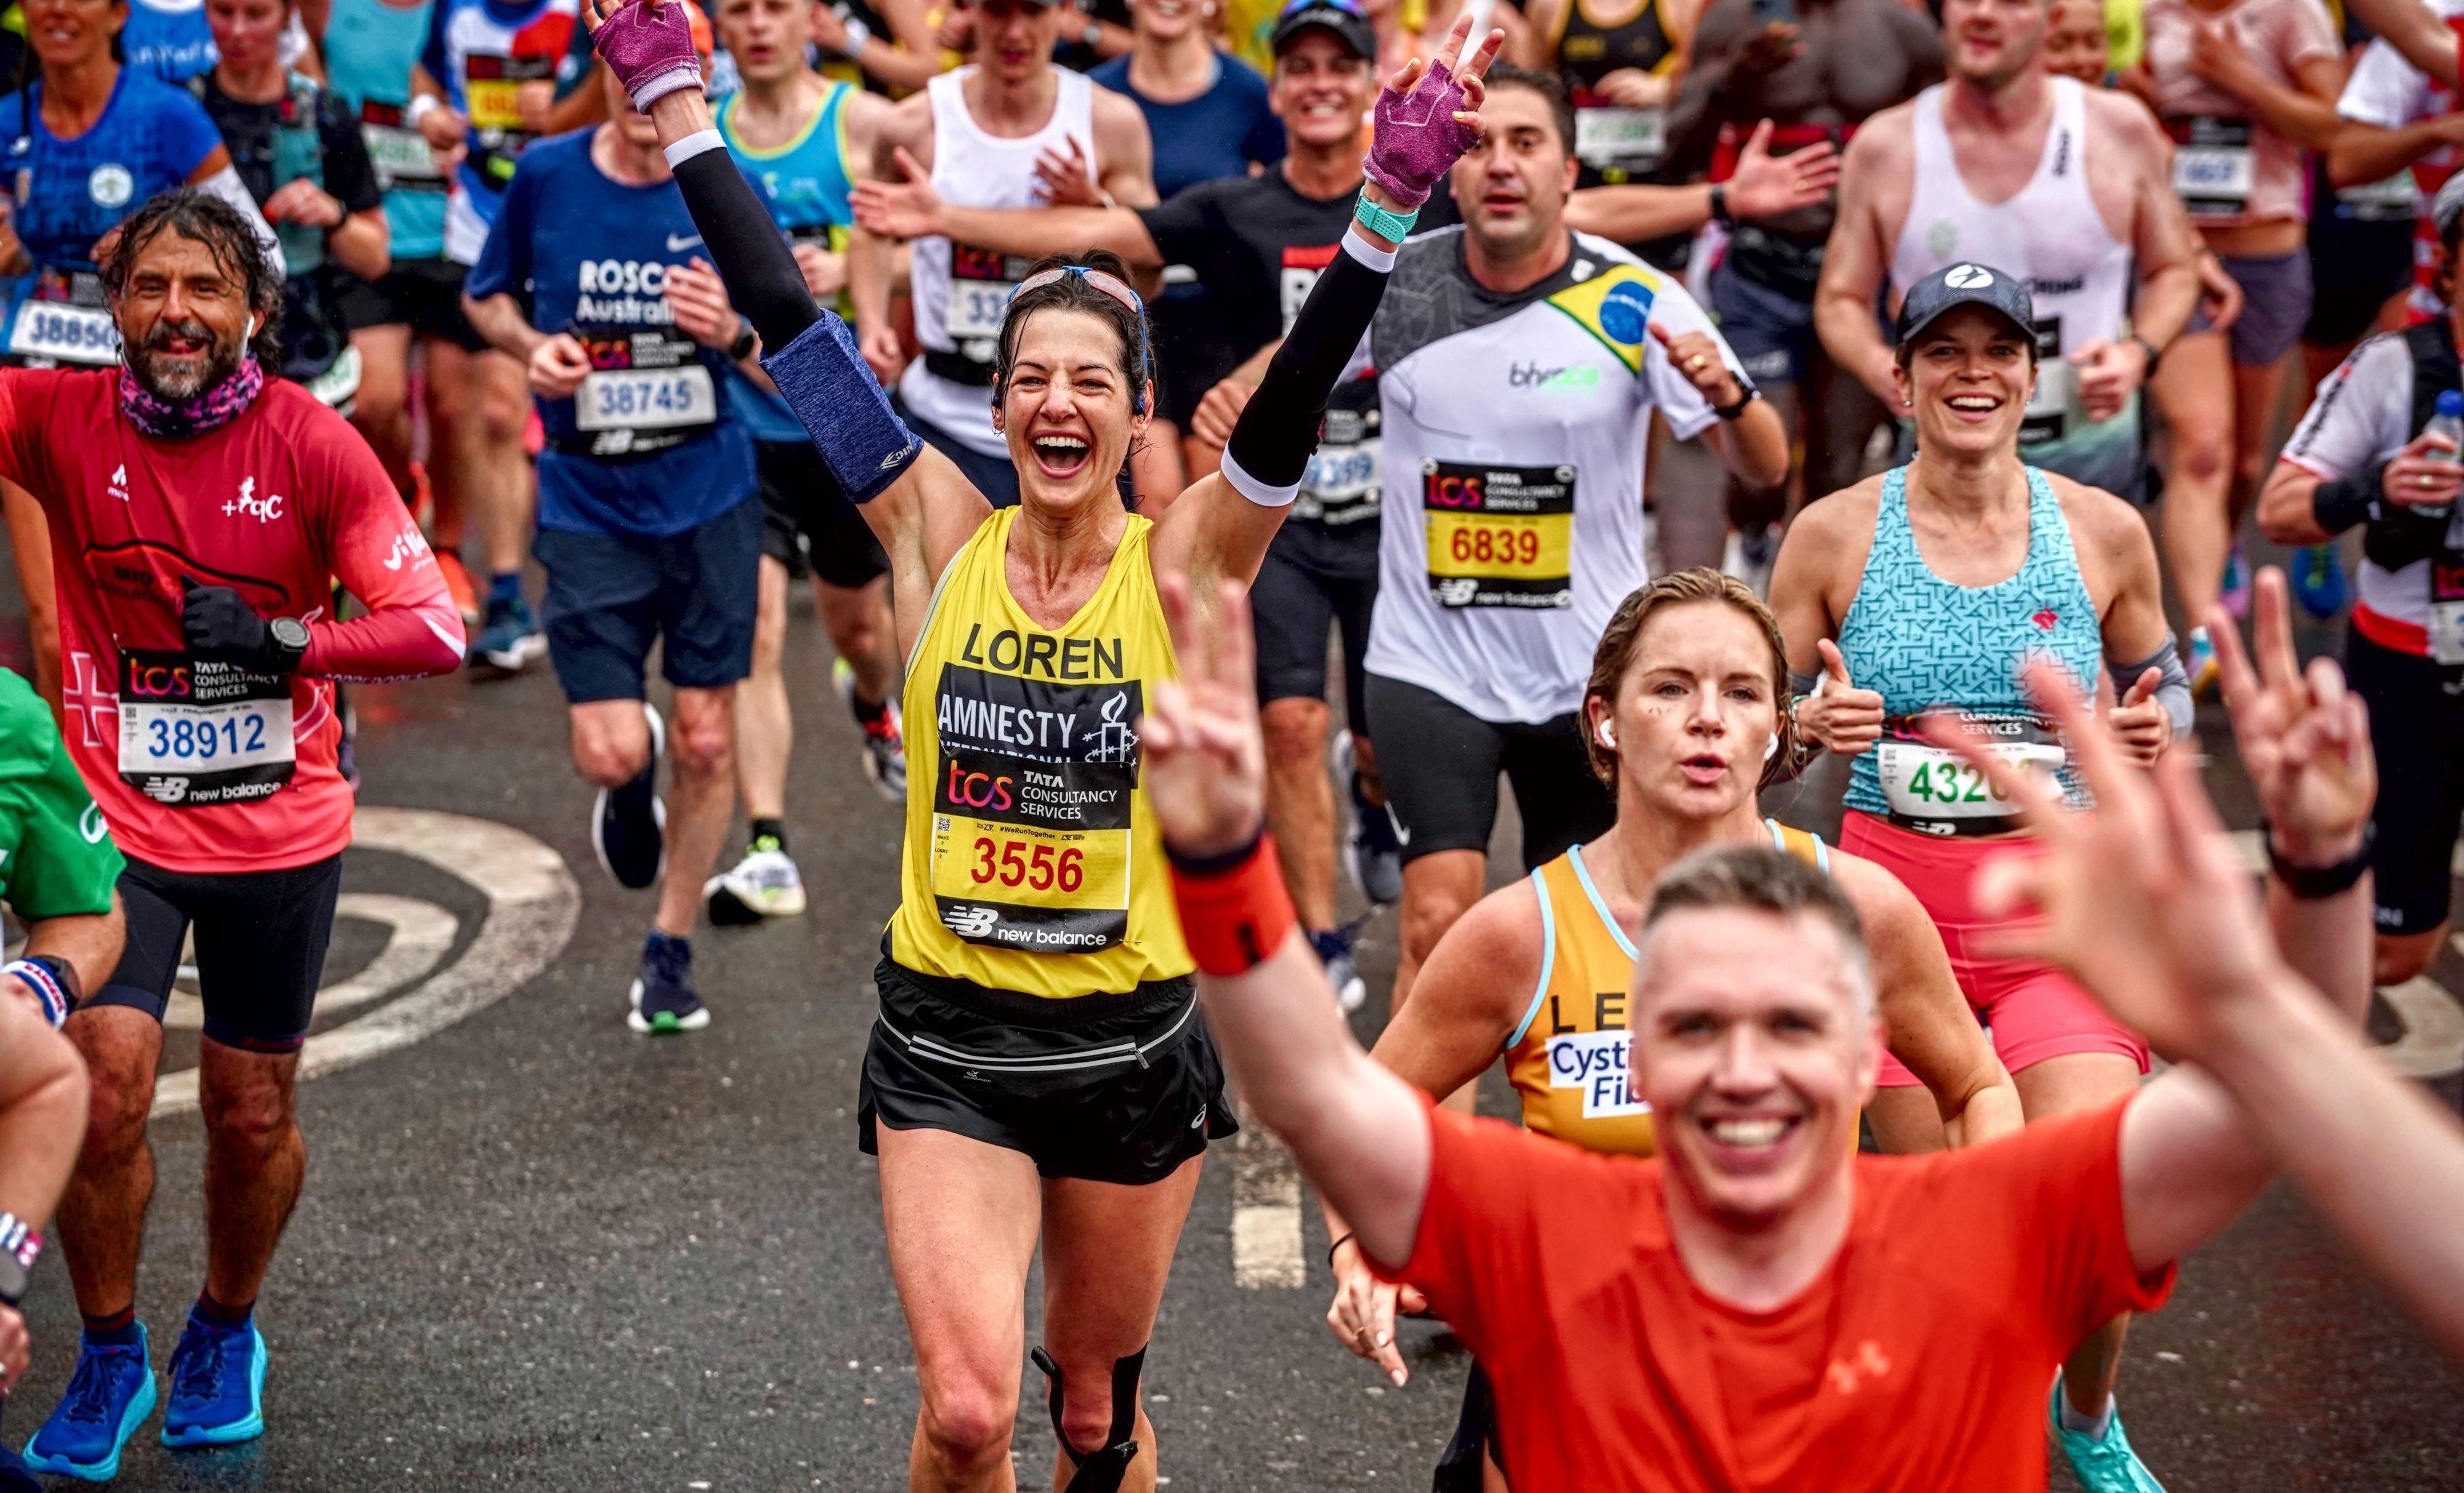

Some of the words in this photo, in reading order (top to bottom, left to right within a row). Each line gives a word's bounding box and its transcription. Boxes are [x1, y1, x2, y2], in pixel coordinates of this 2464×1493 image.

[579, 259, 671, 295] ROSC
[598, 379, 693, 415] 38745
[1429, 474, 1481, 508] tcs
[1452, 527, 1538, 564] 6839
[1475, 592, 1503, 605] new
[962, 623, 1123, 679] LOREN
[131, 658, 190, 695] tcs
[194, 661, 229, 673] TATA
[194, 673, 278, 687] CONSULTANCY
[195, 684, 248, 700] SERVICES
[938, 694, 1076, 749] AMNESTY
[1962, 722, 2023, 735] SERVICES
[148, 713, 265, 758] 38912
[949, 759, 1013, 811] tcs
[1023, 771, 1064, 788] TATA
[190, 789, 219, 801] new
[222, 782, 282, 799] balance
[1021, 787, 1117, 804] CONSULTANCY
[1020, 802, 1081, 819] SERVICES
[1000, 827, 1056, 839] #WeRunTogether
[971, 837, 1084, 892] 3556
[998, 929, 1032, 942] new
[1037, 929, 1106, 945] balance
